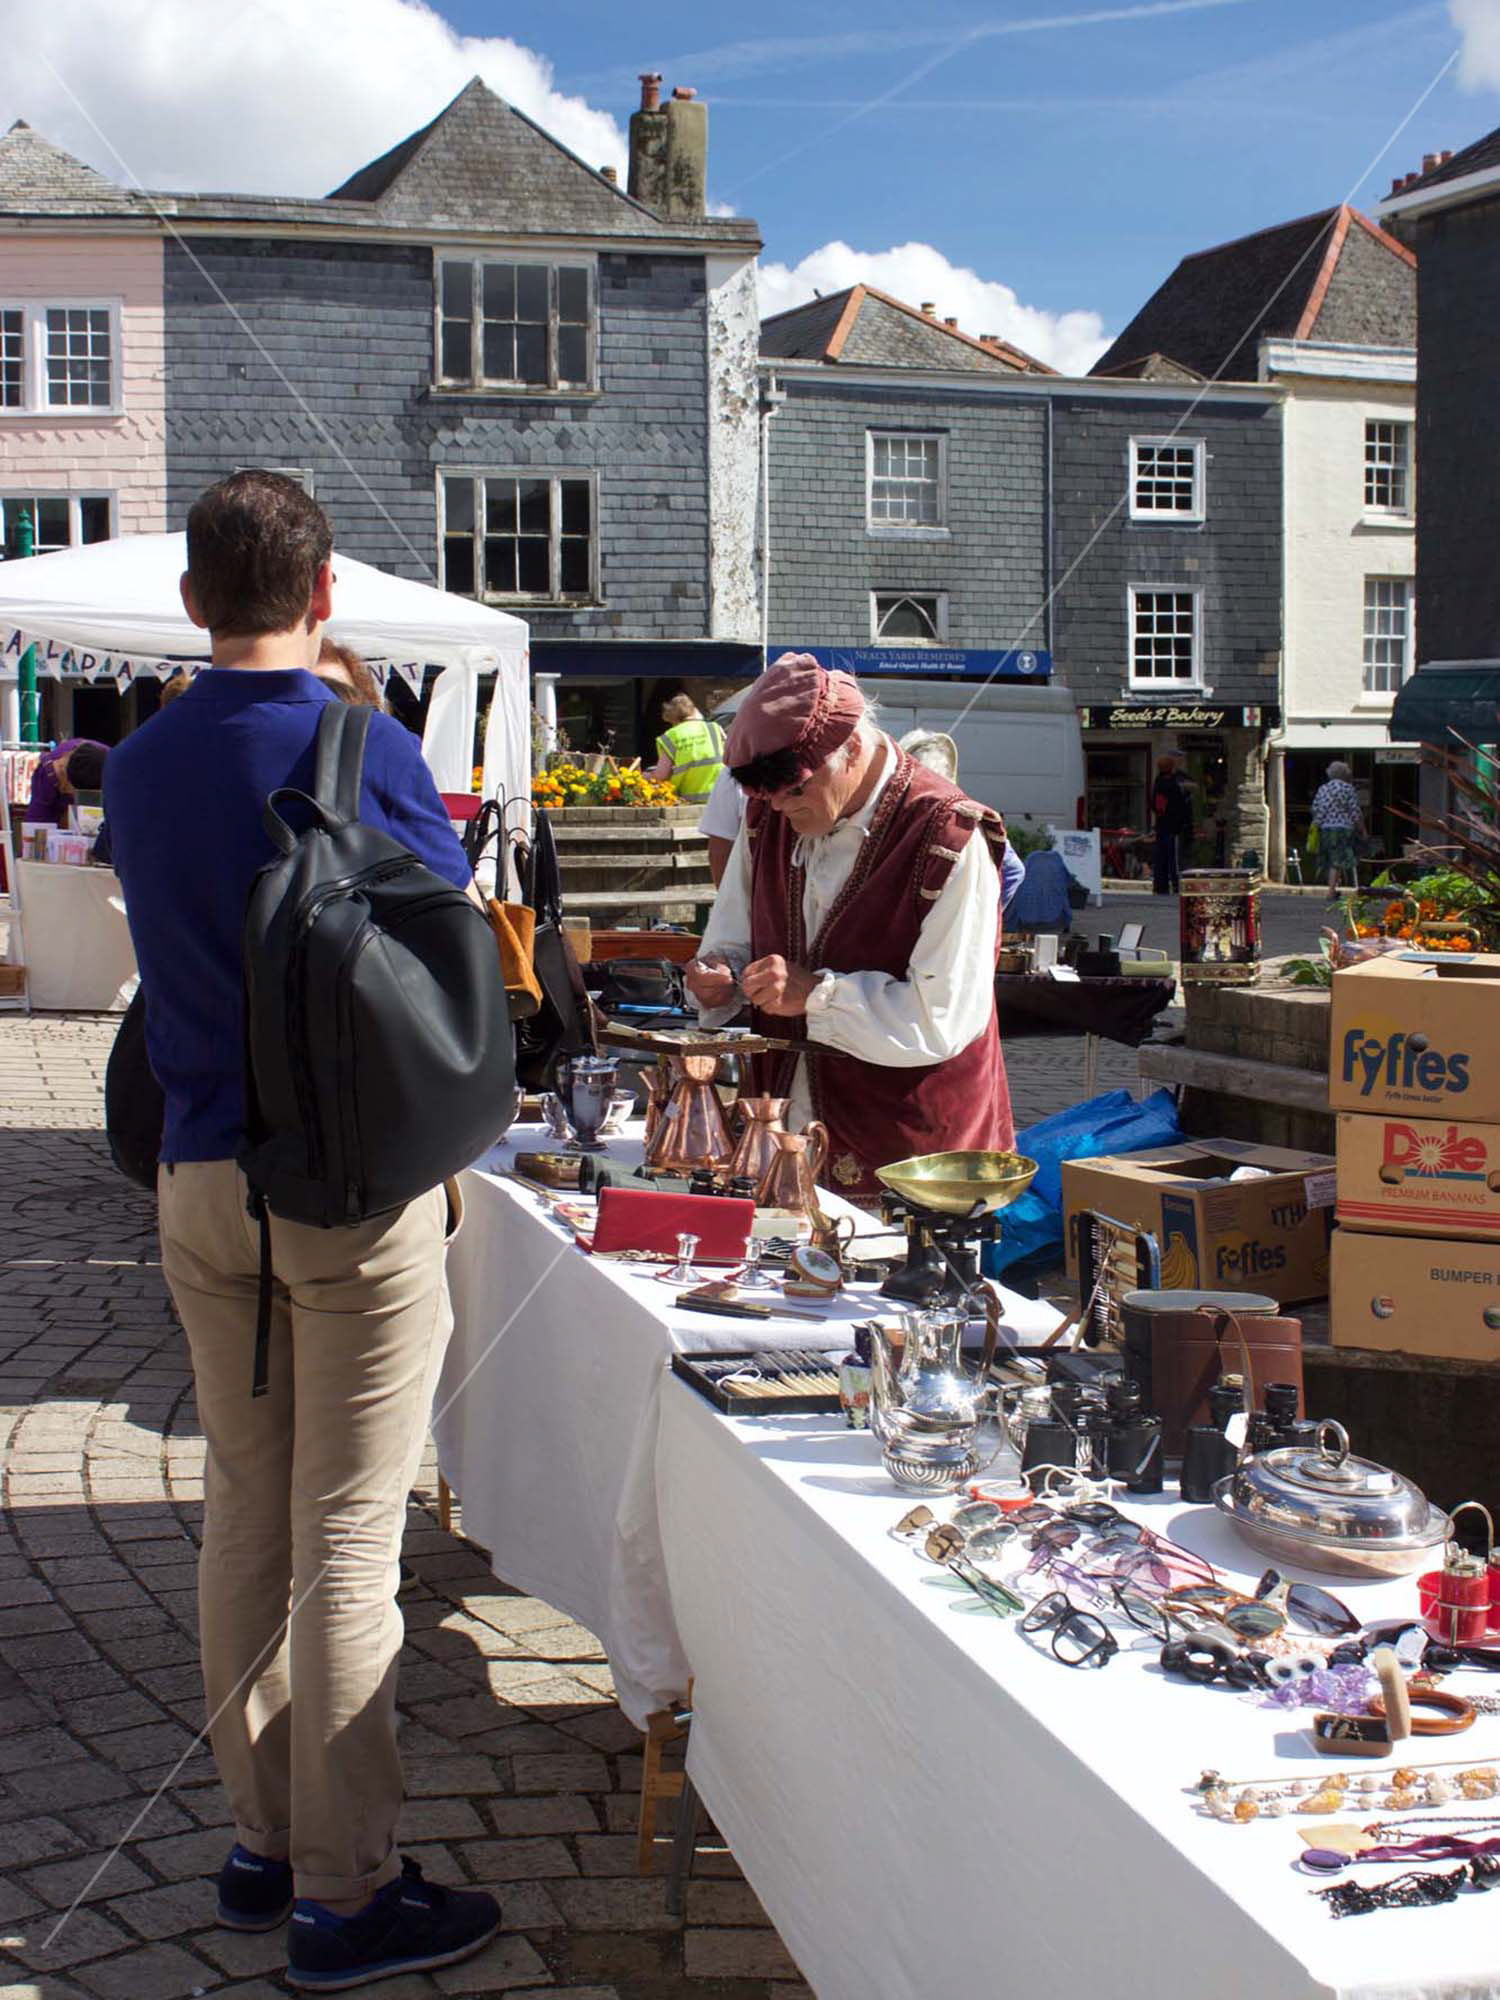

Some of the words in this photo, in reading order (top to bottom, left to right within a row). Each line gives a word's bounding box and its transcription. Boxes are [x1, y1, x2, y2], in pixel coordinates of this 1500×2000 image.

[889, 651, 916, 661] YARD
[917, 651, 967, 662] REMEDIES
[1109, 707, 1153, 721] Seeds
[1152, 708, 1167, 721] 2
[1166, 706, 1225, 728] Bakery
[1342, 1028, 1470, 1097] fyffes
[1383, 1122, 1488, 1173] Dole
[1381, 1186, 1430, 1201] PREMIUM
[1431, 1191, 1488, 1206] BANANAS
[1430, 1267, 1493, 1285] BUMPER
